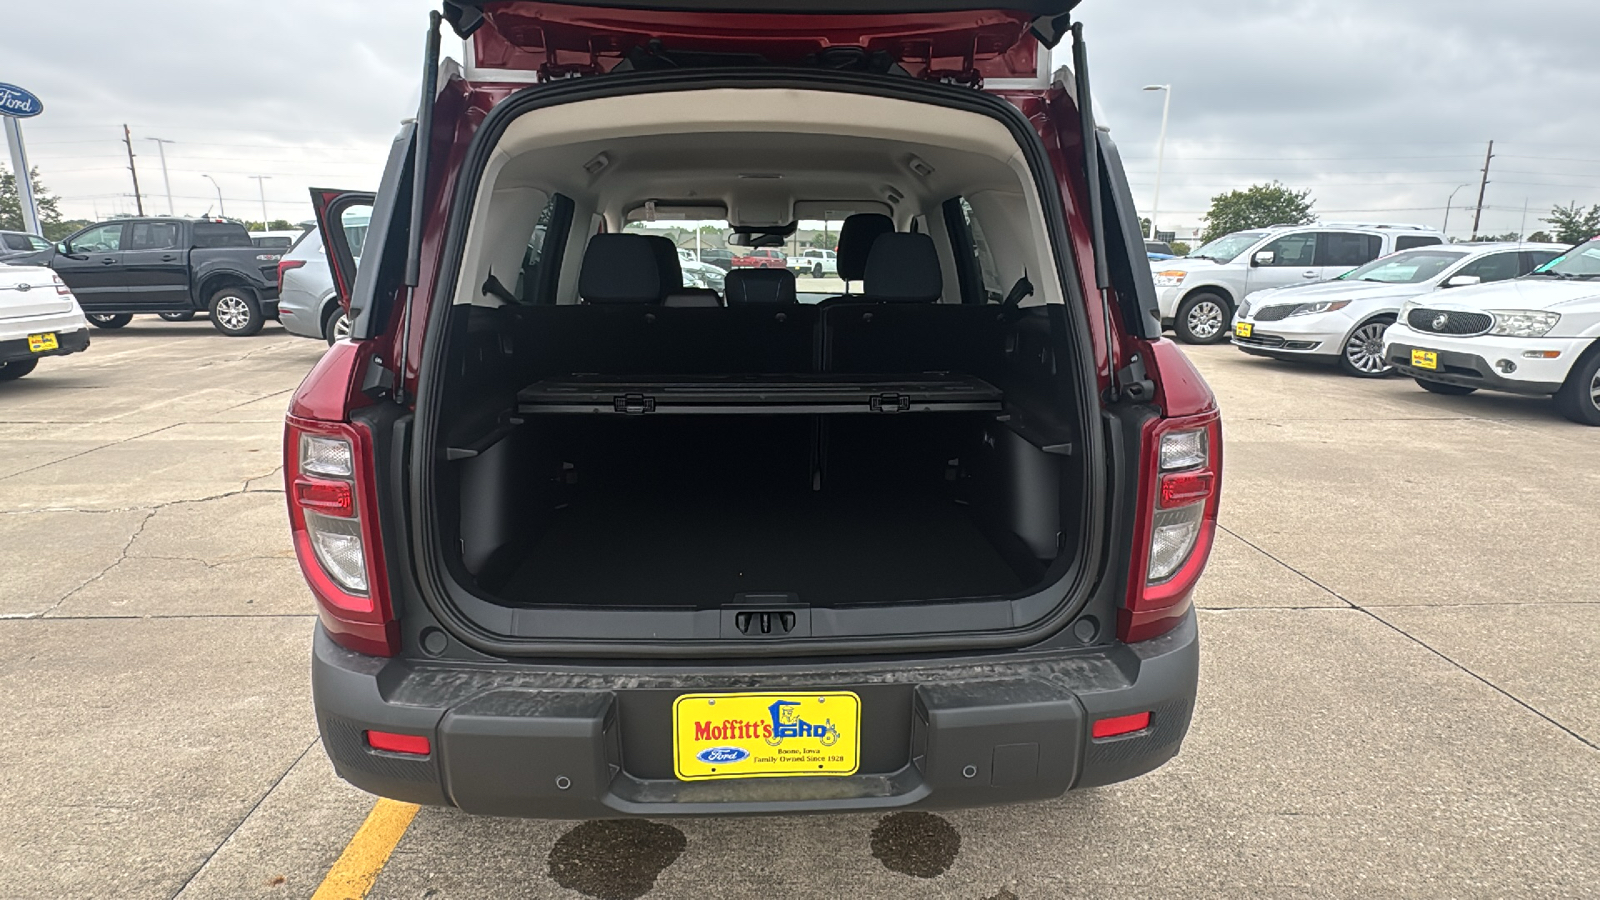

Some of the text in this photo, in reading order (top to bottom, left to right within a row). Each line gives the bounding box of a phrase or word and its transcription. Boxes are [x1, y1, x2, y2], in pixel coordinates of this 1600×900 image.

[0, 88, 32, 112] Ford
[694, 719, 772, 741] Moffitt's
[708, 749, 738, 761] Ford
[753, 756, 778, 764] Family
